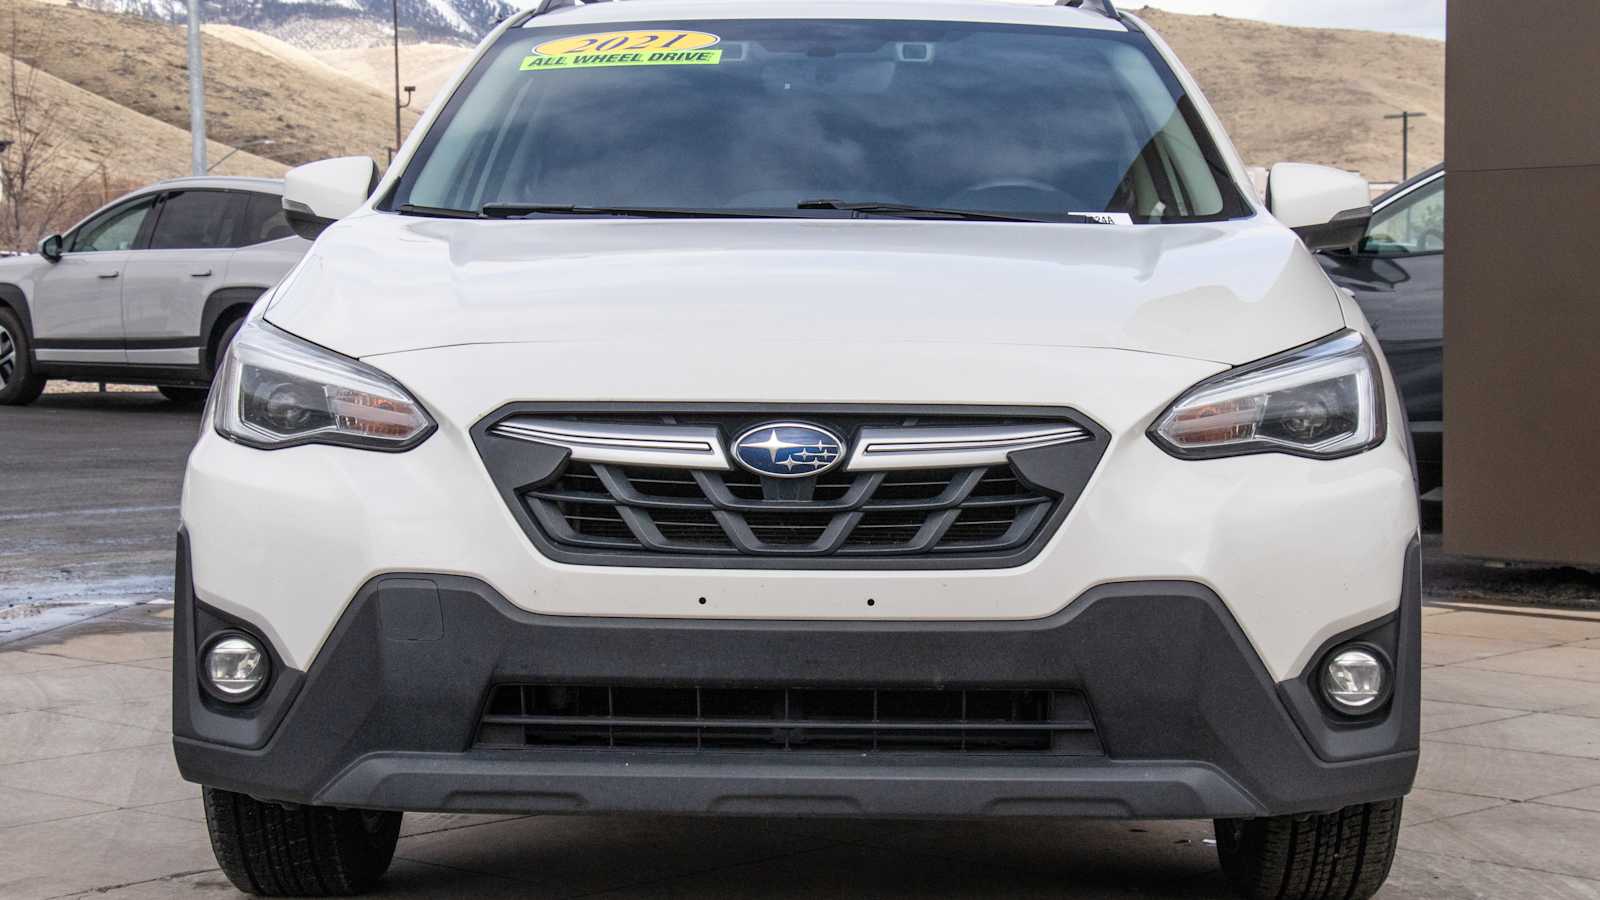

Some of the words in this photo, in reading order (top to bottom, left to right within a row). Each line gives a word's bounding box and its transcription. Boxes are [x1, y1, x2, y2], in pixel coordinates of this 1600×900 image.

[565, 33, 688, 54] 2021
[527, 56, 567, 67] ALL
[572, 52, 643, 64] WHEEL
[647, 51, 711, 62] DRIVE
